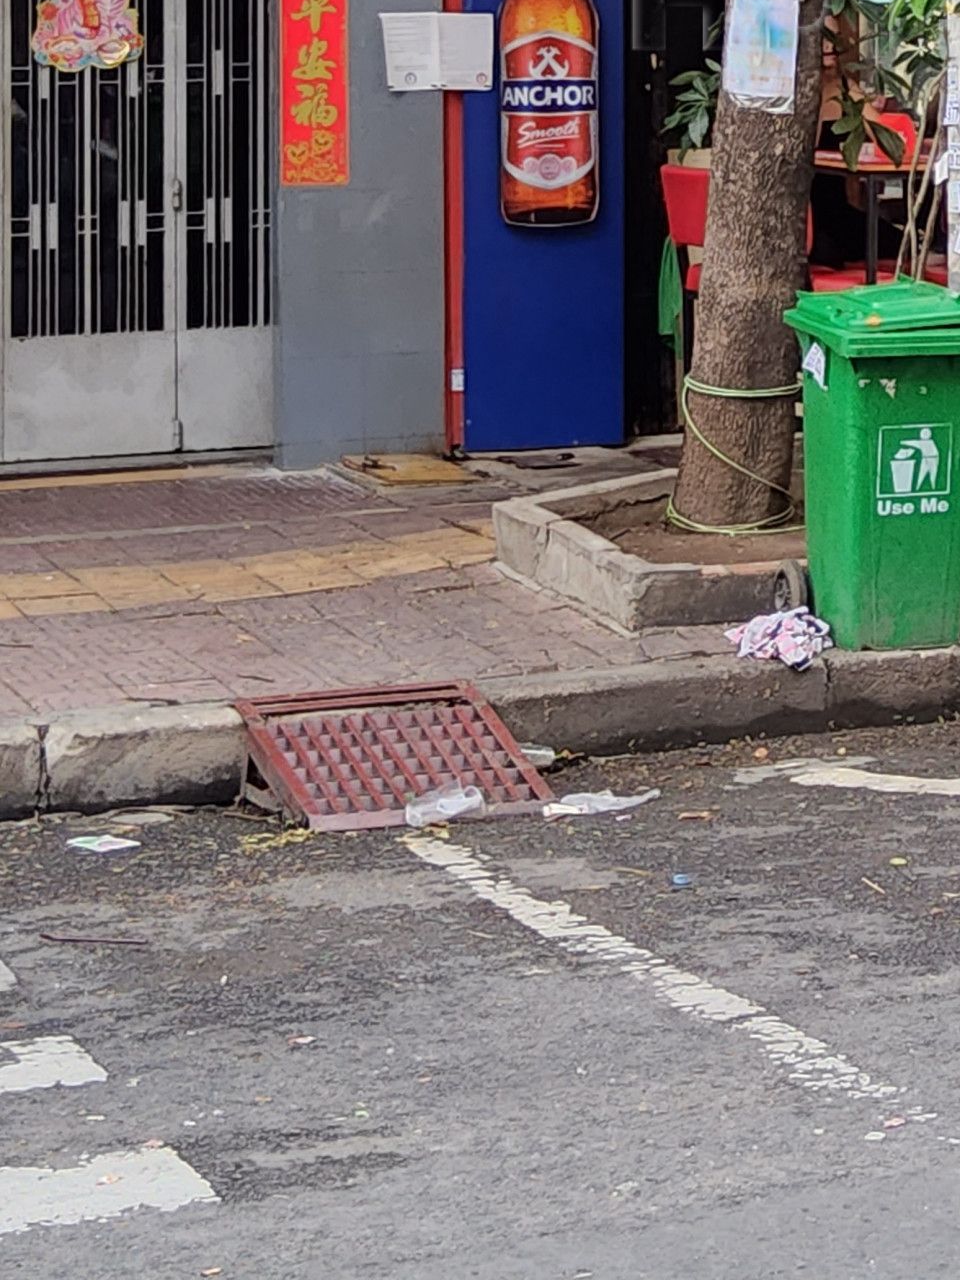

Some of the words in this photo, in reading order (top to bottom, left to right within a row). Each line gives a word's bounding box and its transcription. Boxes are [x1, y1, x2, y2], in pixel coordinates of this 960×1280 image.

[502, 85, 595, 107] ANCHOR
[516, 117, 581, 145] Smooth
[877, 500, 915, 517] Use
[920, 497, 950, 514] Me
